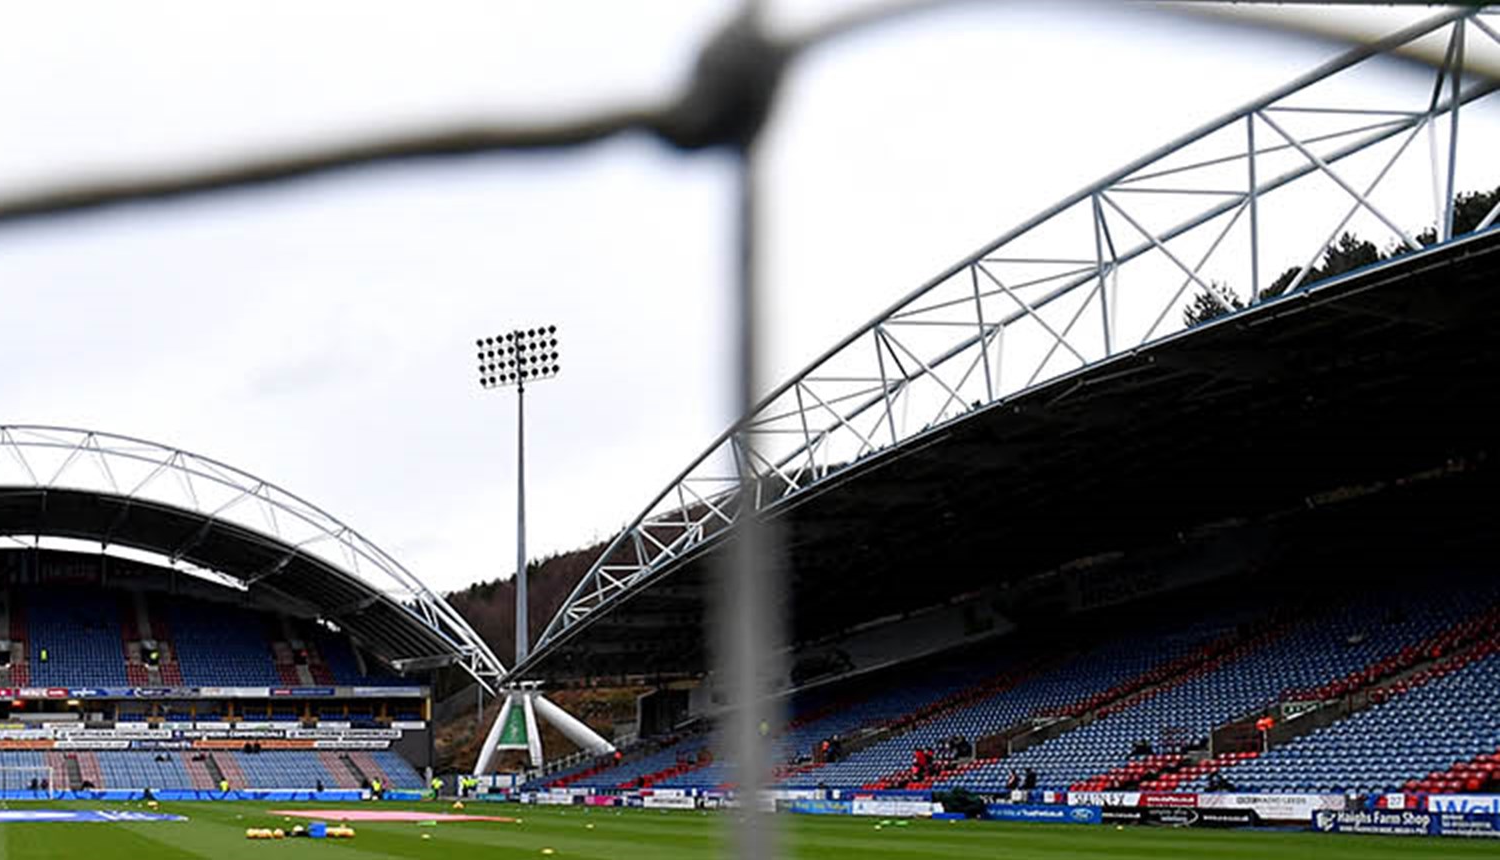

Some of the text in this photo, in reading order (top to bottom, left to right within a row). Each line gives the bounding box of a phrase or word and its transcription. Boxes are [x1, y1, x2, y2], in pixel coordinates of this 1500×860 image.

[1337, 811, 1372, 828] Haighs
[1373, 811, 1401, 823] Farm
[1402, 811, 1431, 828] Shop
